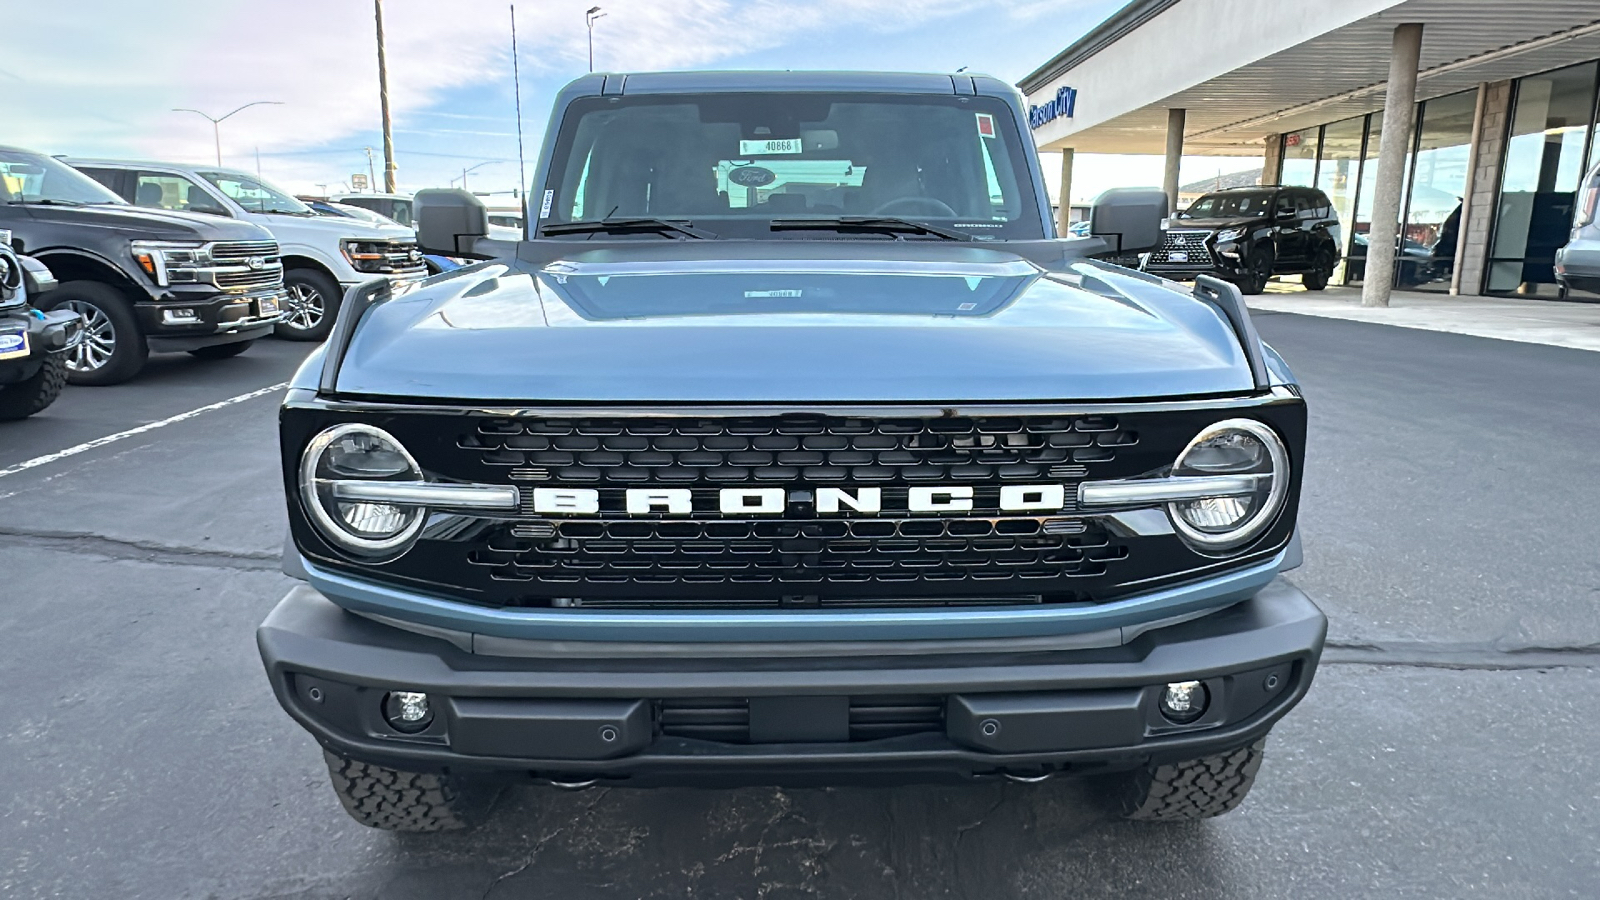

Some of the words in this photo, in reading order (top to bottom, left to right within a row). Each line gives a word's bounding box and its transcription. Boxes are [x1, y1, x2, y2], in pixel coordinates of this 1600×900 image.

[1055, 86, 1077, 118] City
[765, 140, 792, 151] 40868
[738, 170, 767, 183] Ford
[533, 485, 1065, 514] BRONCO
